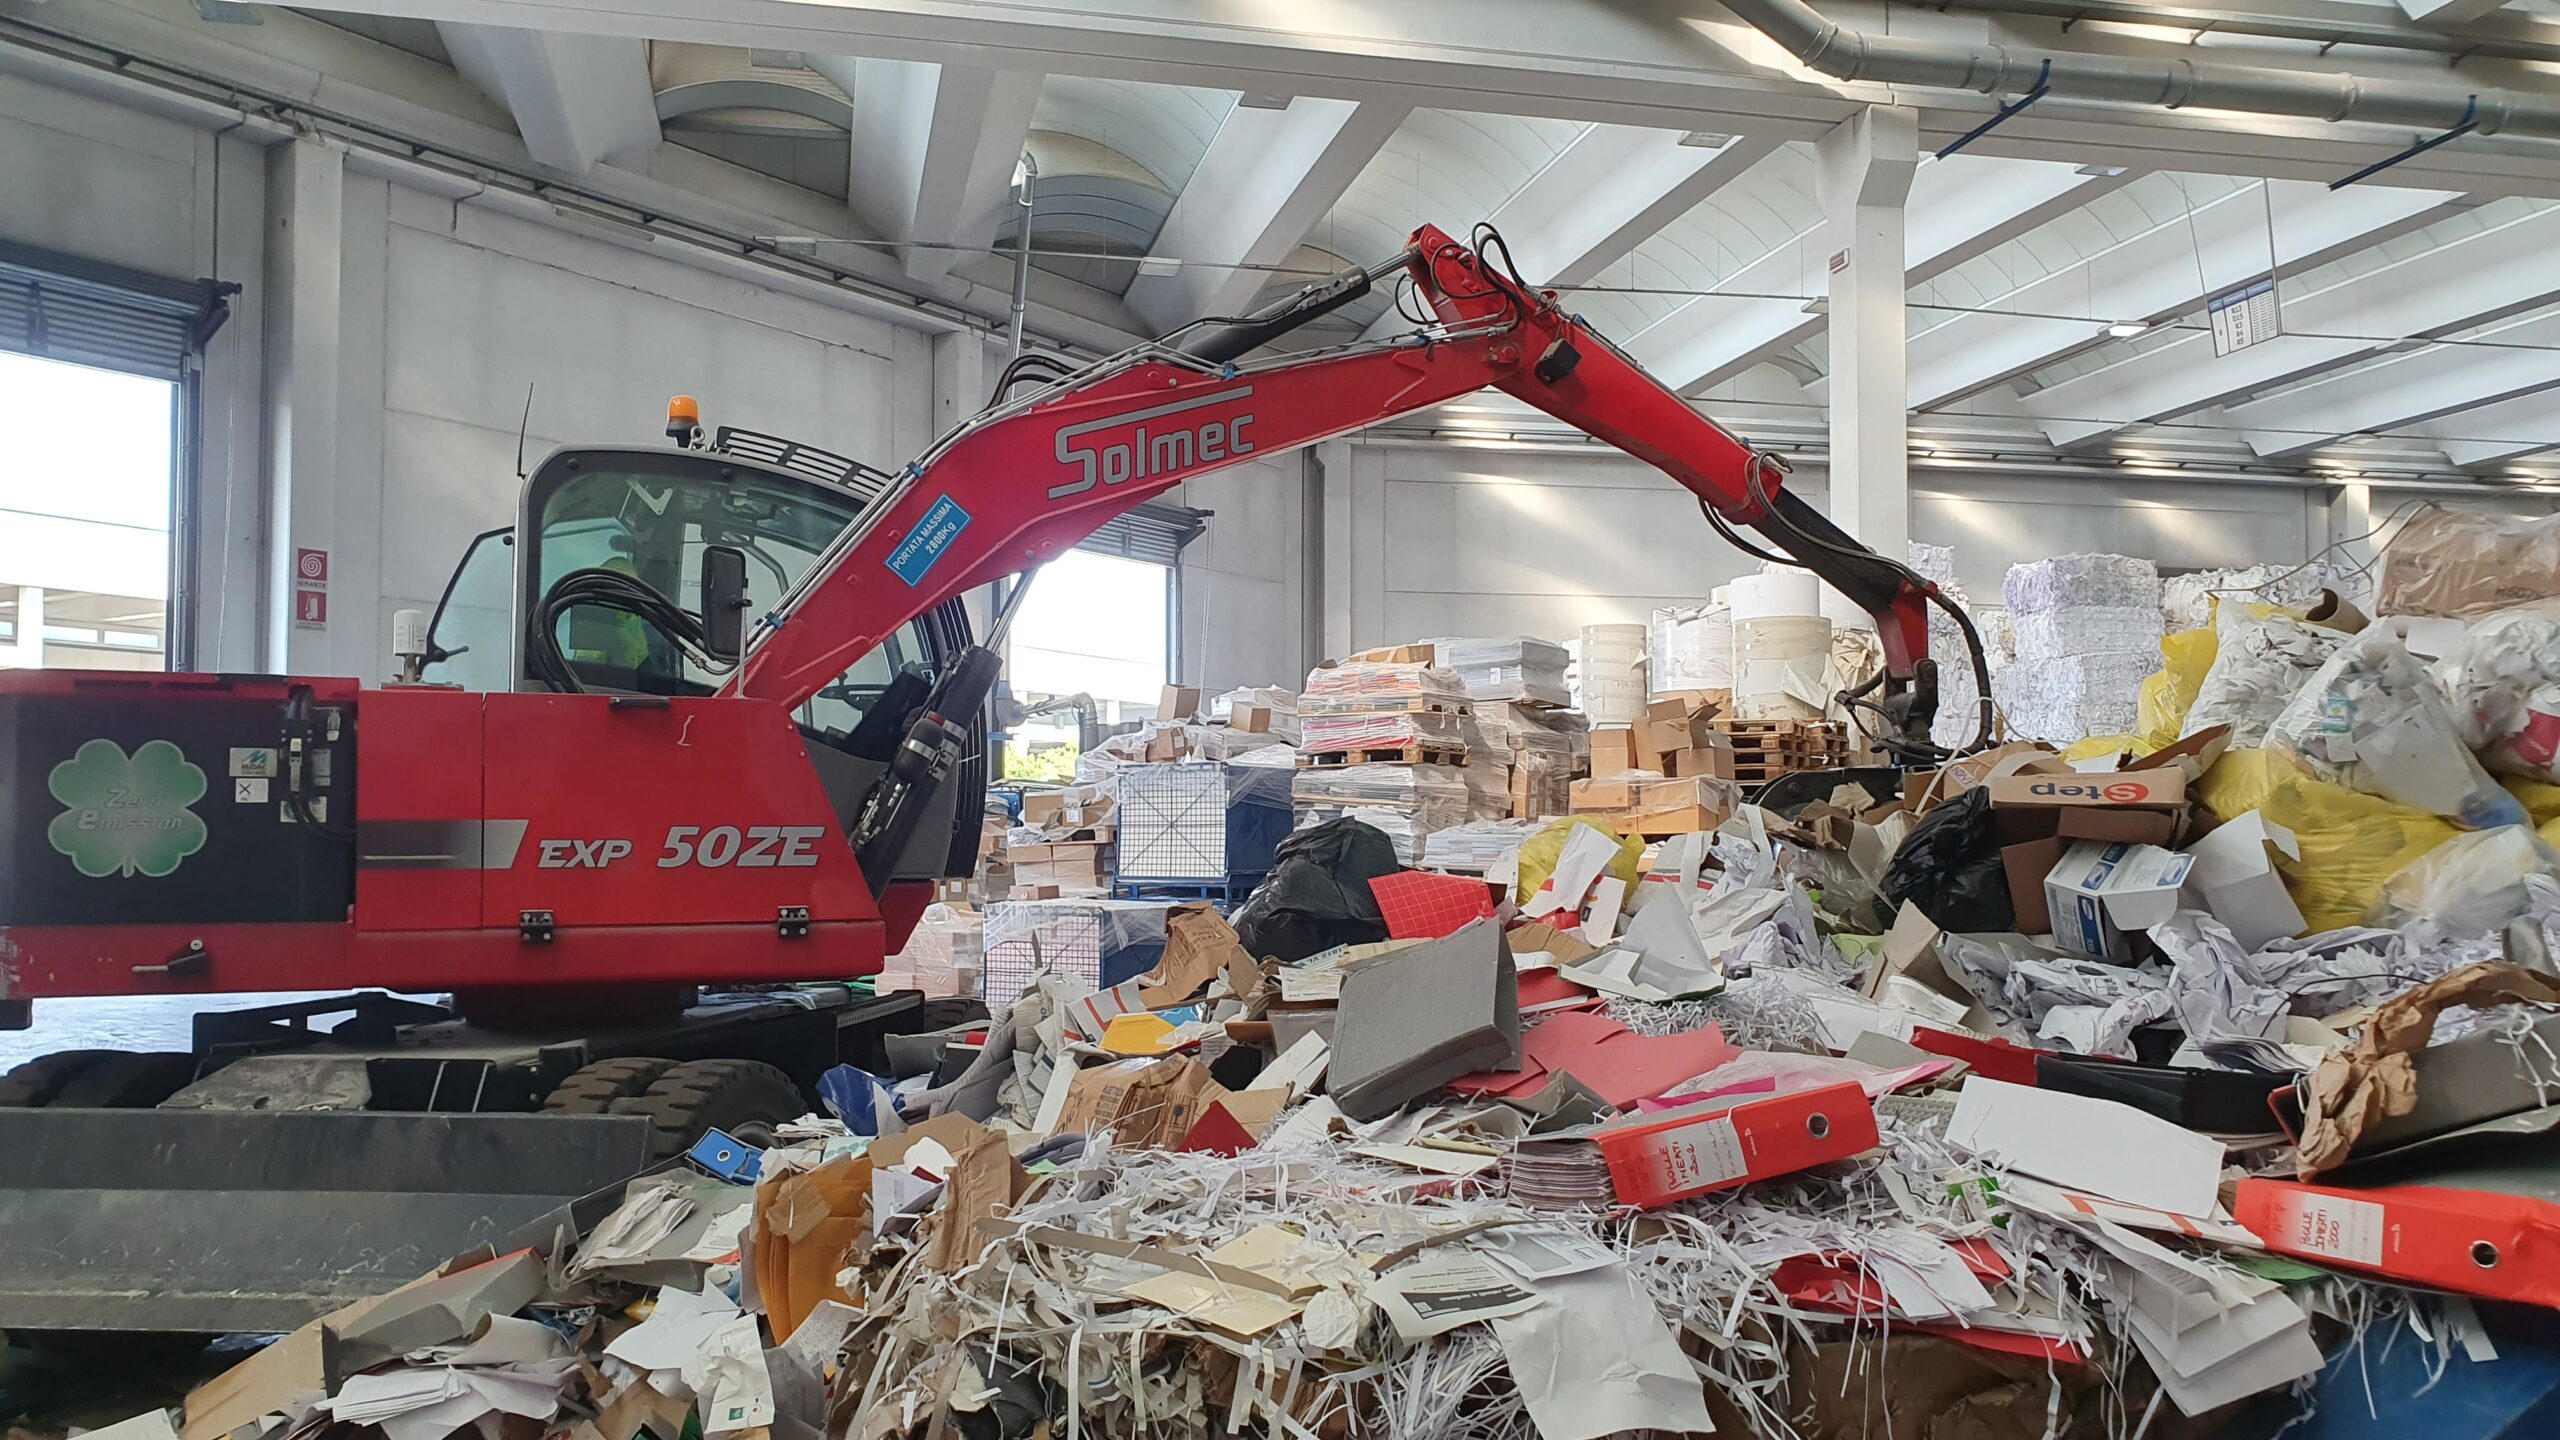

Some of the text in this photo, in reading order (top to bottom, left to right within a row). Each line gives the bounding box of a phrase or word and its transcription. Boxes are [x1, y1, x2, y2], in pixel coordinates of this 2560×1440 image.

[1048, 384, 1255, 500] Solmec
[892, 502, 953, 570] PORTATA MASSIMA
[104, 786, 162, 809] Zero
[2029, 781, 2149, 804] Step
[537, 825, 826, 869] EXP 50ZE
[1657, 1145, 1683, 1191] BOLLE
